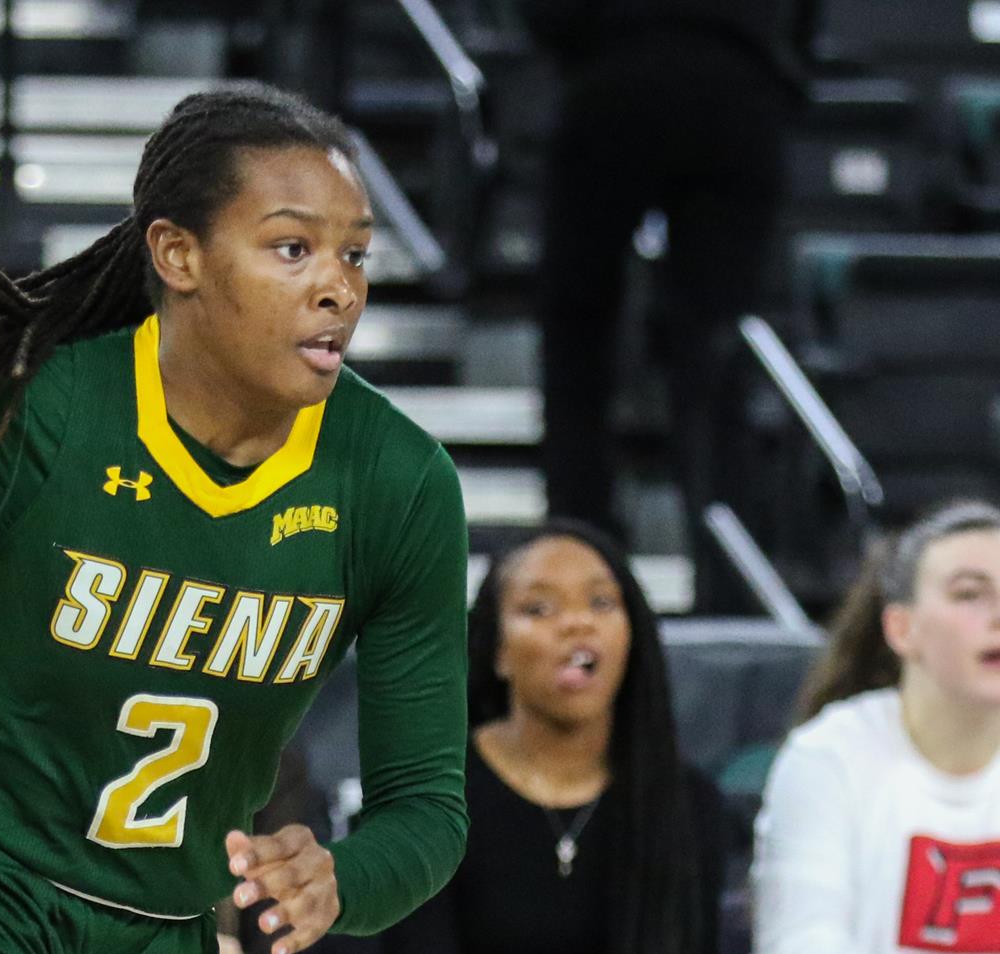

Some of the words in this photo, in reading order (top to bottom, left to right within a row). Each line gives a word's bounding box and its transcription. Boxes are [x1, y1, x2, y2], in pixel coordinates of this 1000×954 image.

[270, 505, 339, 546] MAAC
[51, 549, 346, 684] SIENA
[86, 694, 219, 848] 2
